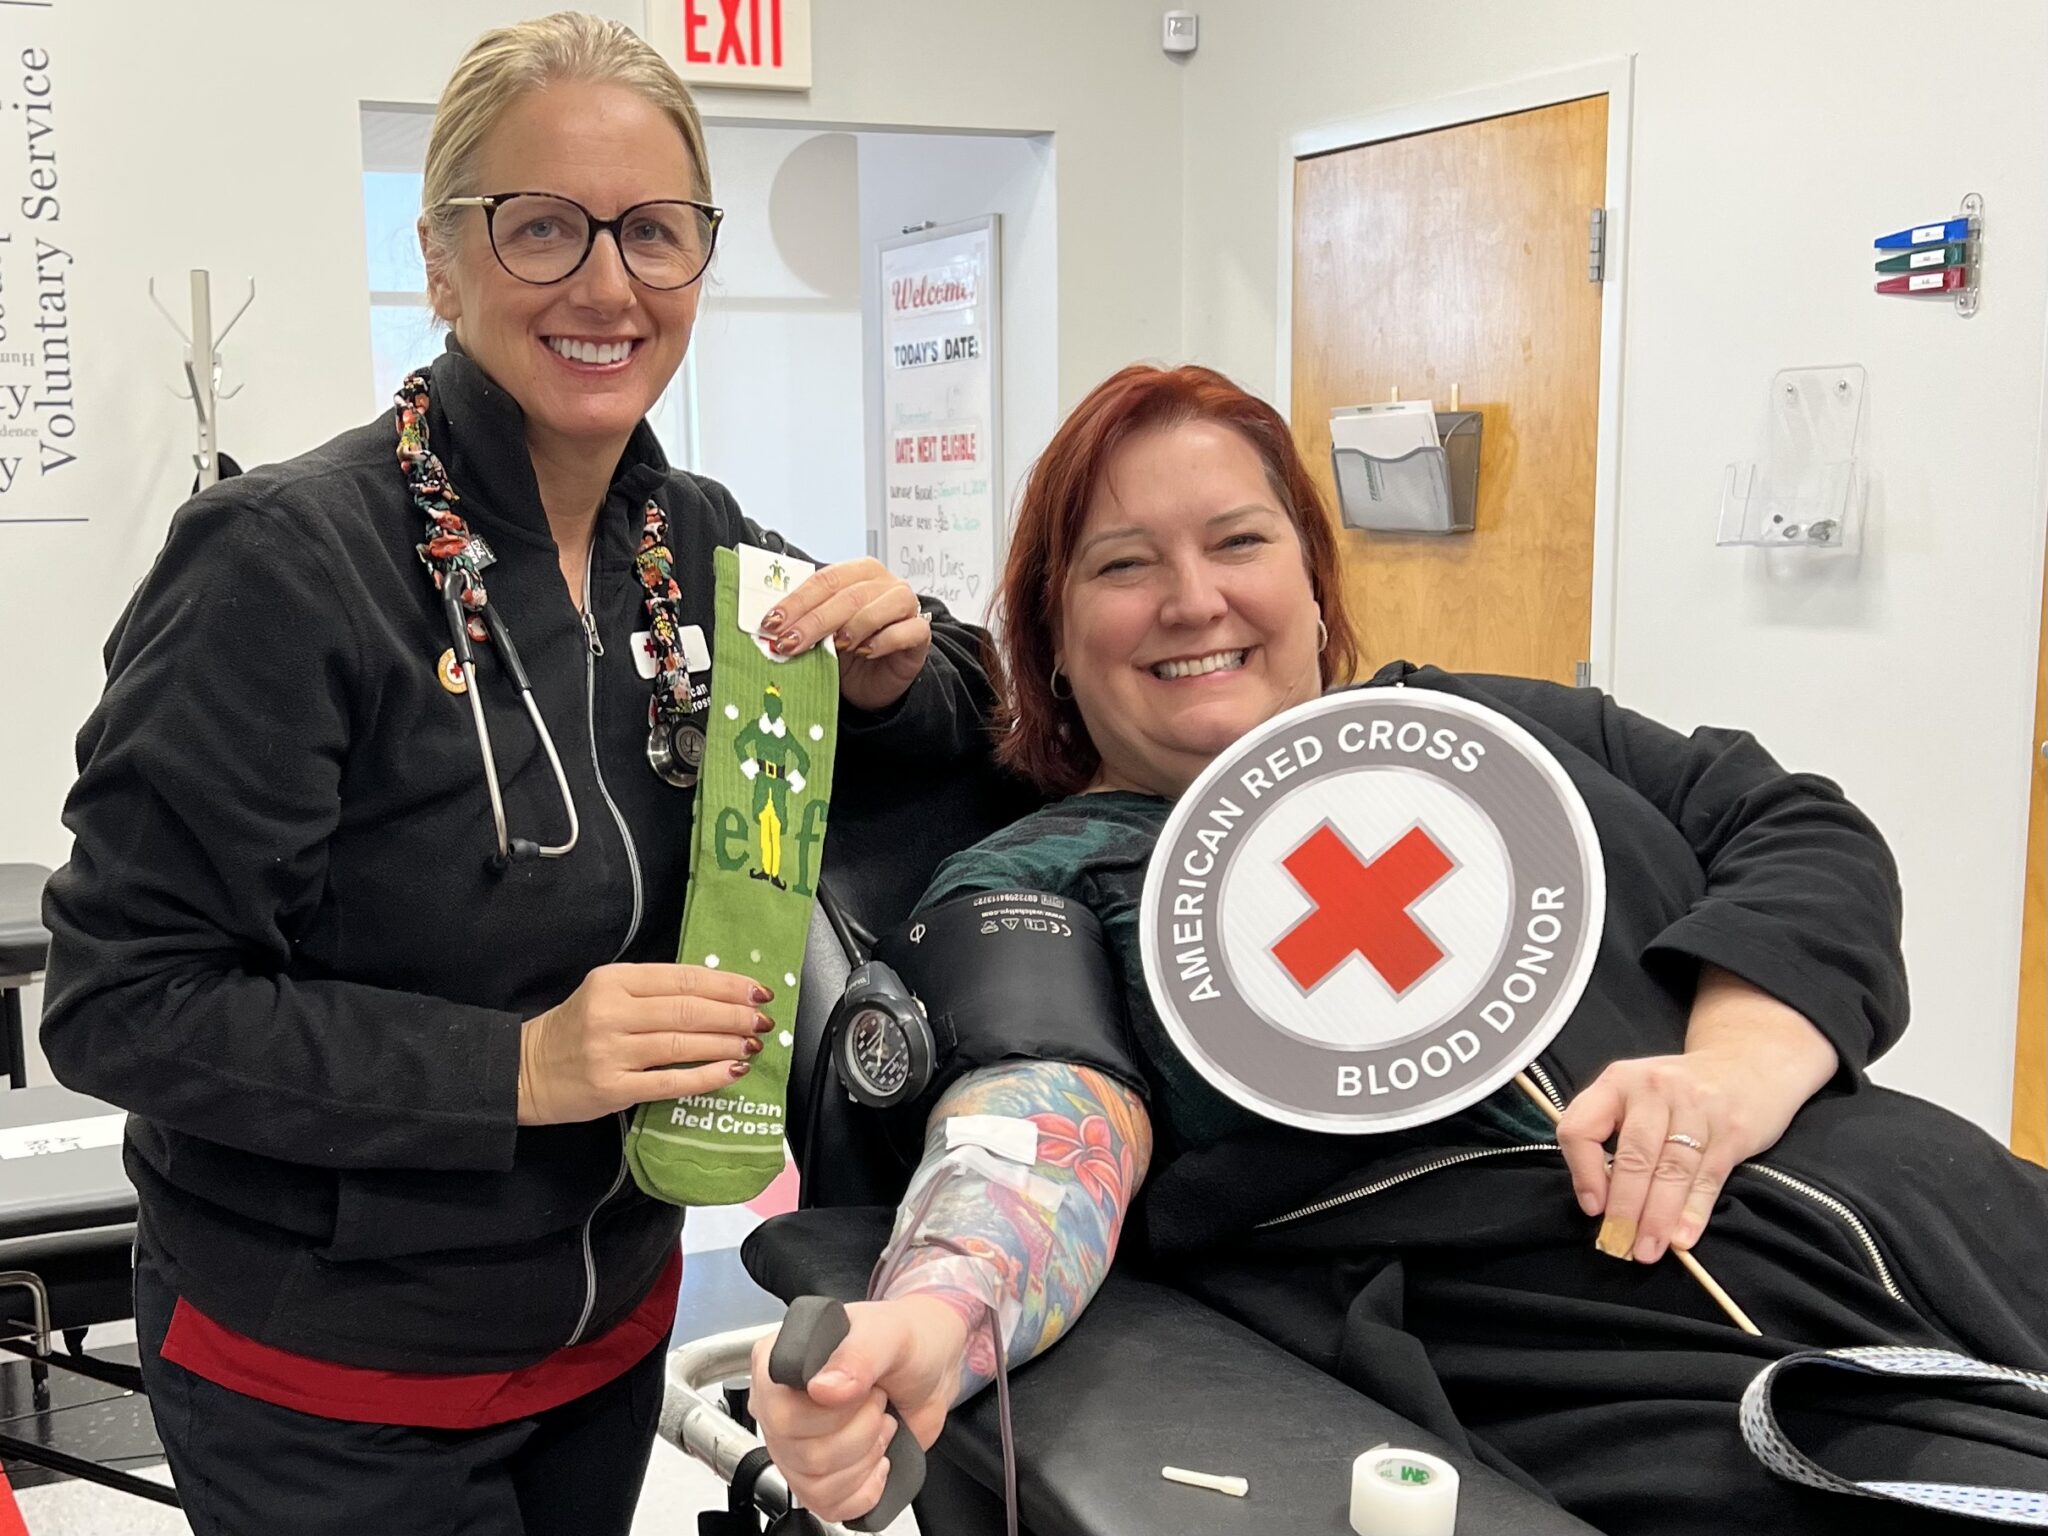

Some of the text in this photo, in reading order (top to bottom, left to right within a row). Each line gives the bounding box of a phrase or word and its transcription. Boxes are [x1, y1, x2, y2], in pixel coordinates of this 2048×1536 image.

[12, 47, 78, 476] Voluntary Service
[894, 341, 938, 366] TODAY'S
[1173, 720, 1486, 1003] AMERICAN RED CROSS
[1336, 886, 1566, 1097] BLOOD DONOR
[670, 1106, 784, 1136] Red Cross
[677, 1095, 782, 1118] American
[1401, 1465, 1430, 1485] 3M
